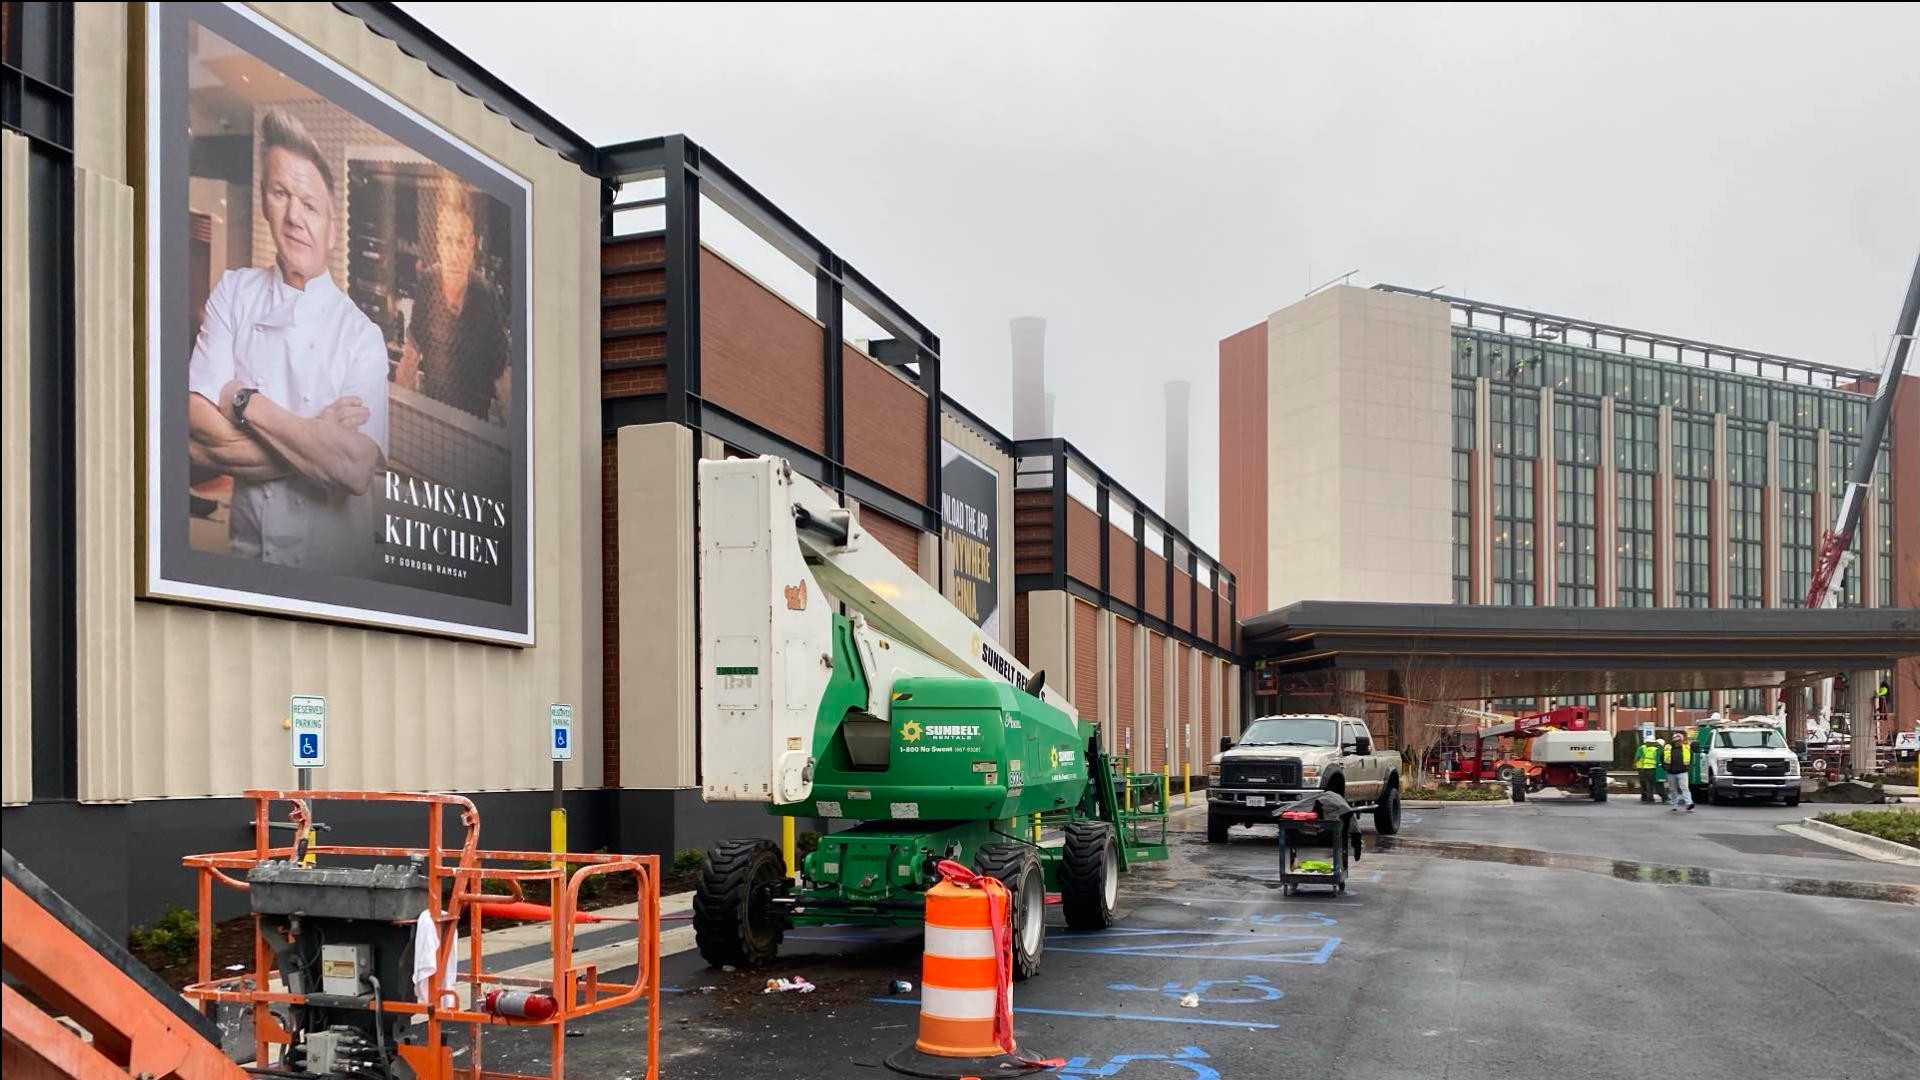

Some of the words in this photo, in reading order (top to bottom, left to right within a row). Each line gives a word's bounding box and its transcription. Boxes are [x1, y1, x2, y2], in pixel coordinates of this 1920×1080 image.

[385, 471, 506, 528] RAMSAY'S
[965, 504, 977, 536] THE
[385, 514, 499, 566] KITCHEN
[385, 554, 395, 564] BY
[399, 557, 433, 572] GORDON
[436, 564, 467, 579] RAMSAY
[982, 642, 1015, 685] SUNBELT
[293, 705, 324, 714] RESERVED
[295, 719, 321, 728] PARKING
[925, 725, 980, 735] SUNBELT
